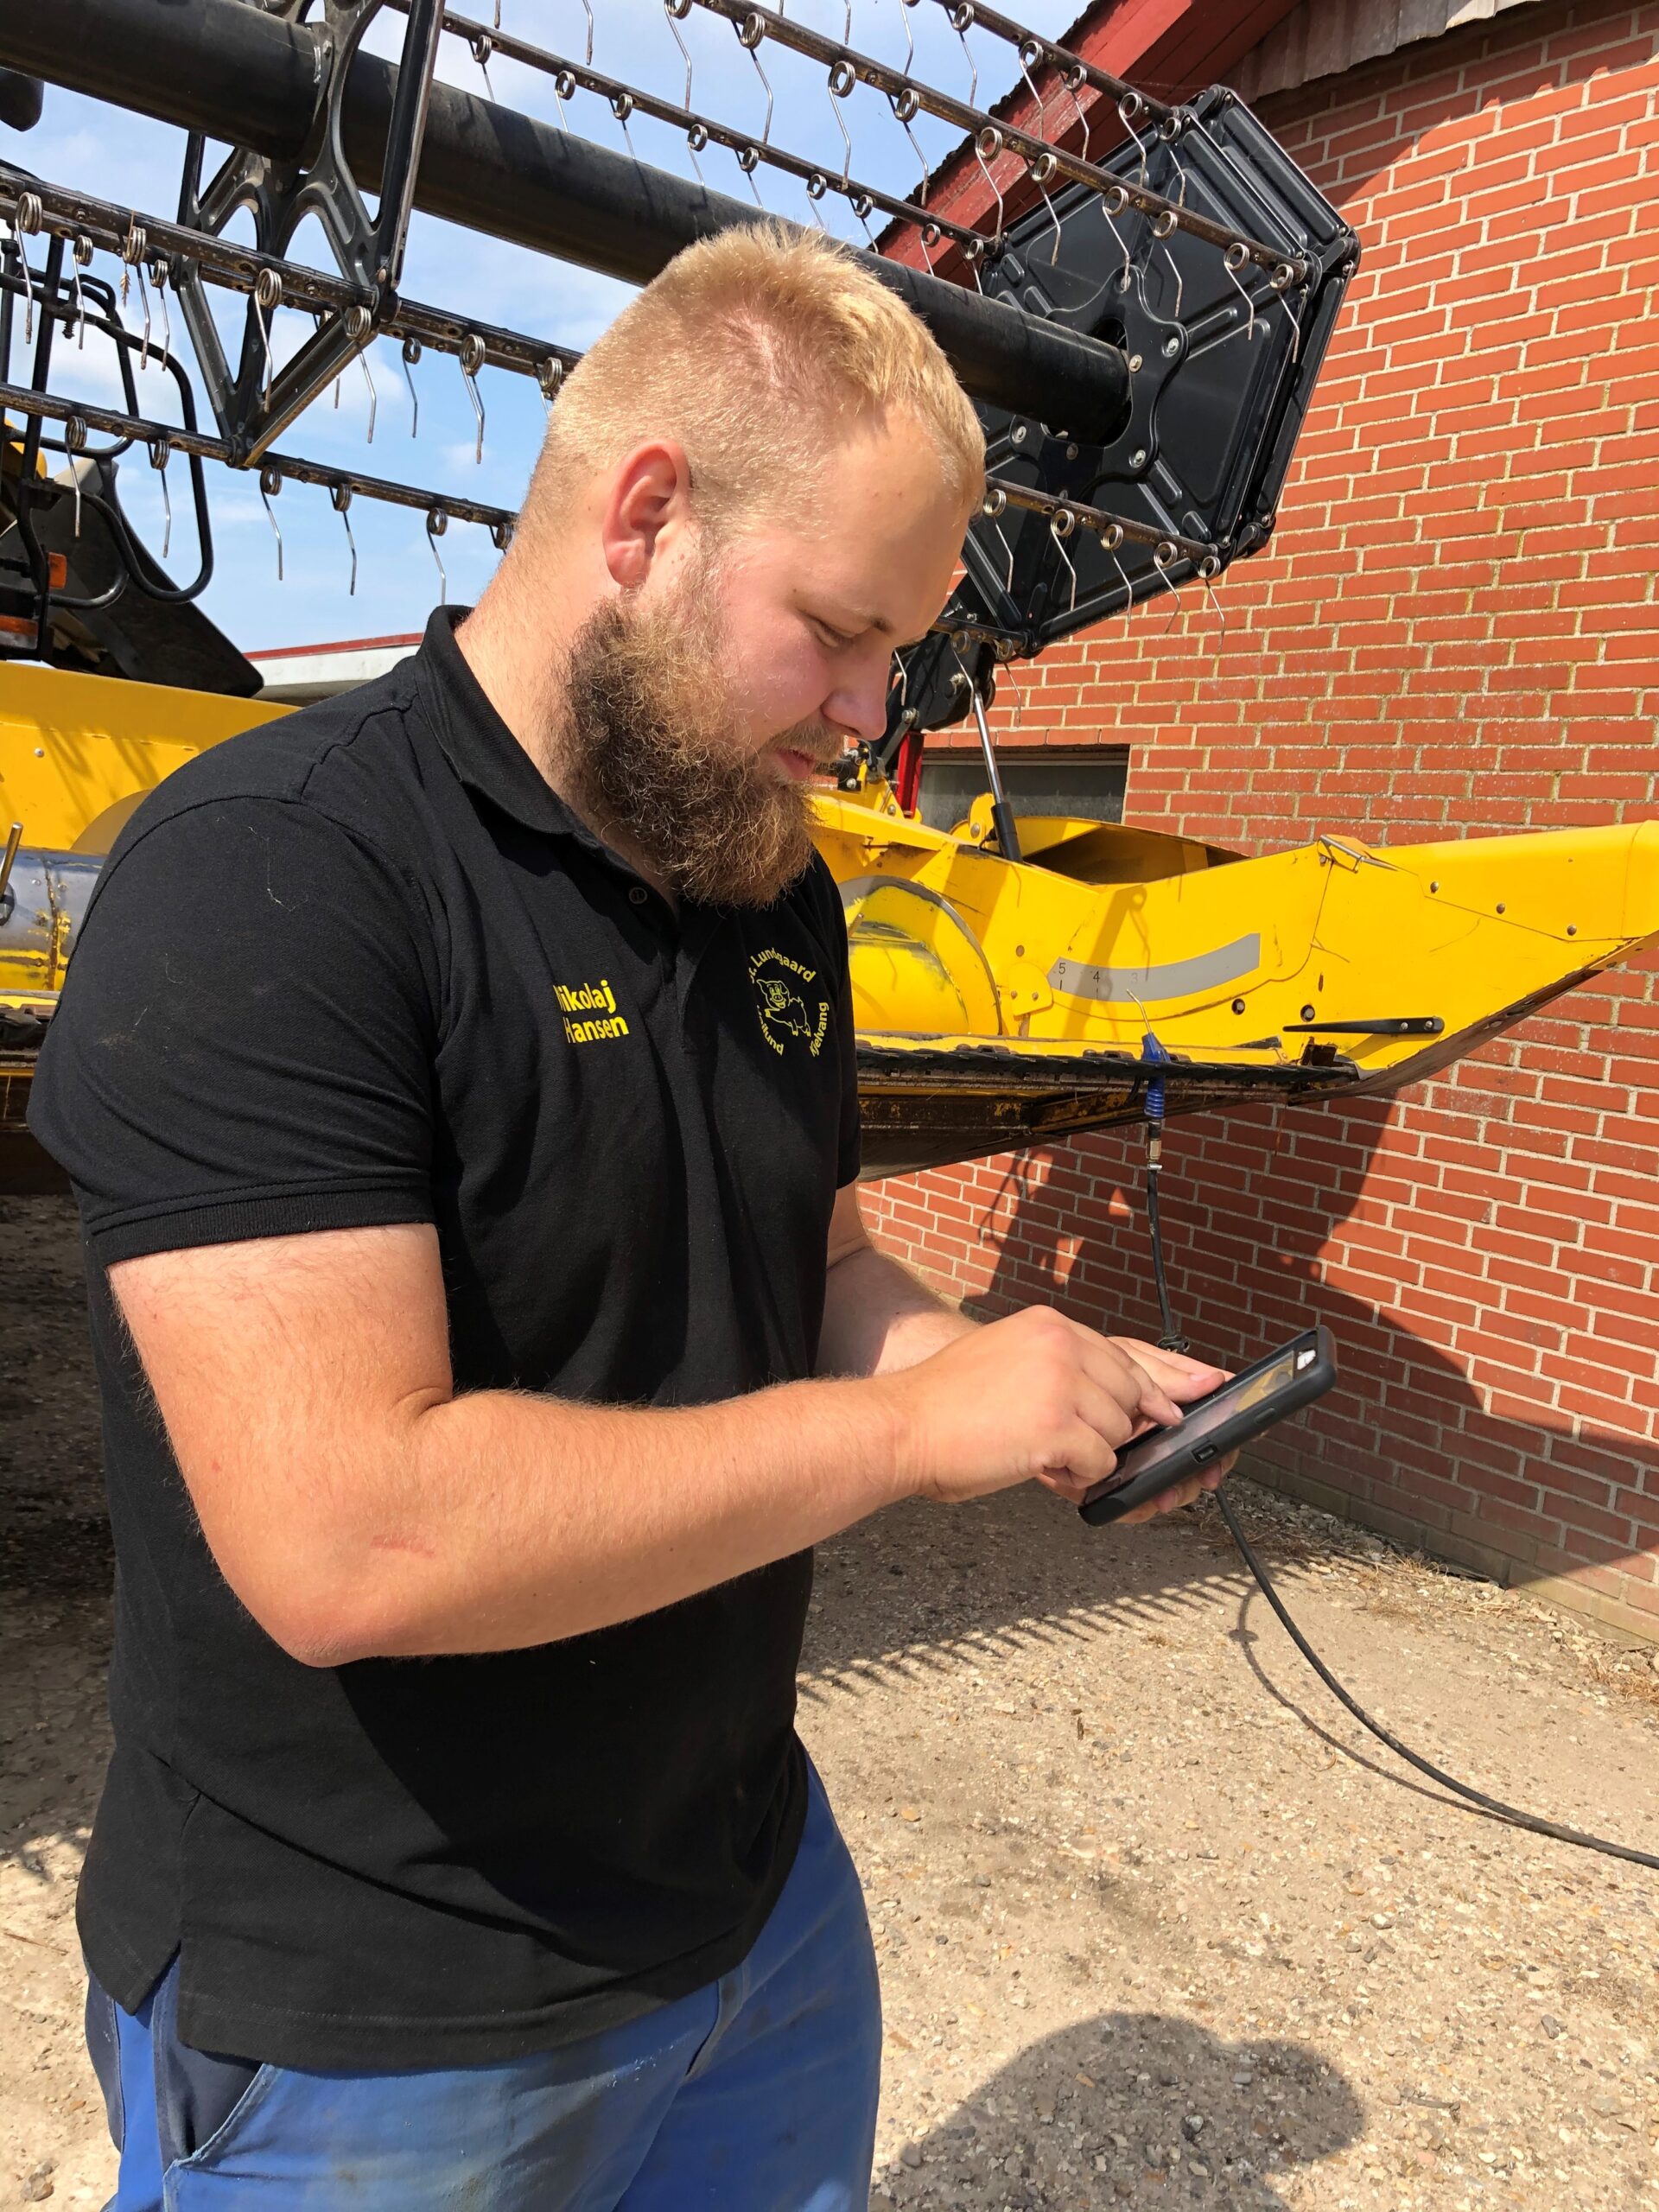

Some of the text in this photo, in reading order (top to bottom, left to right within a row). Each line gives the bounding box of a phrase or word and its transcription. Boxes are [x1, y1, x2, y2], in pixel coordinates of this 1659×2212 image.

[750, 947, 816, 982] Lundgaard
[1058, 963, 1066, 975] 5
[1092, 970, 1101, 982] 4
[563, 1016, 629, 1043] Hansen
